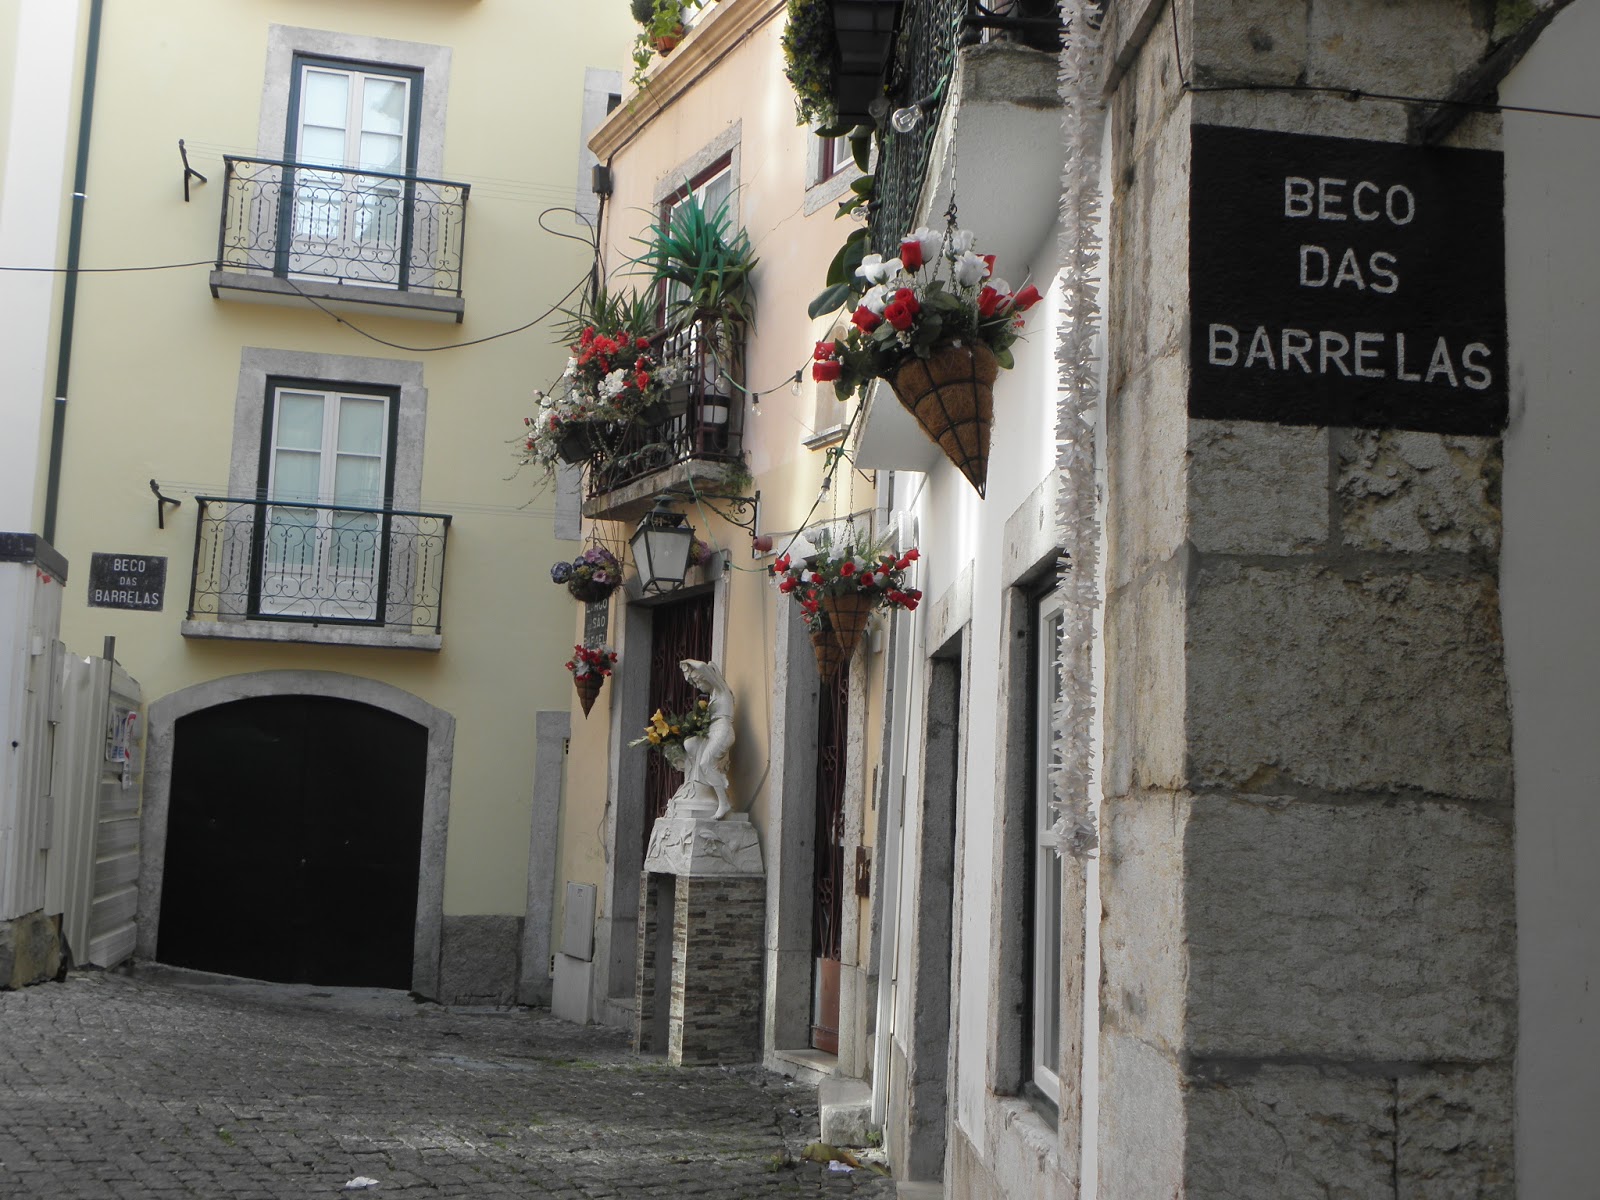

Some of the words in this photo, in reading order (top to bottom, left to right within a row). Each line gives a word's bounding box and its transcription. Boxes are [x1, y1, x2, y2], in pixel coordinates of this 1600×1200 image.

[1284, 176, 1416, 225] BECO
[1300, 245, 1400, 294] DAS
[1208, 323, 1492, 390] BARRELAS
[113, 558, 146, 573] BECO
[119, 576, 138, 586] DAS
[95, 589, 159, 605] BARRELAS
[586, 599, 608, 613] LRGO
